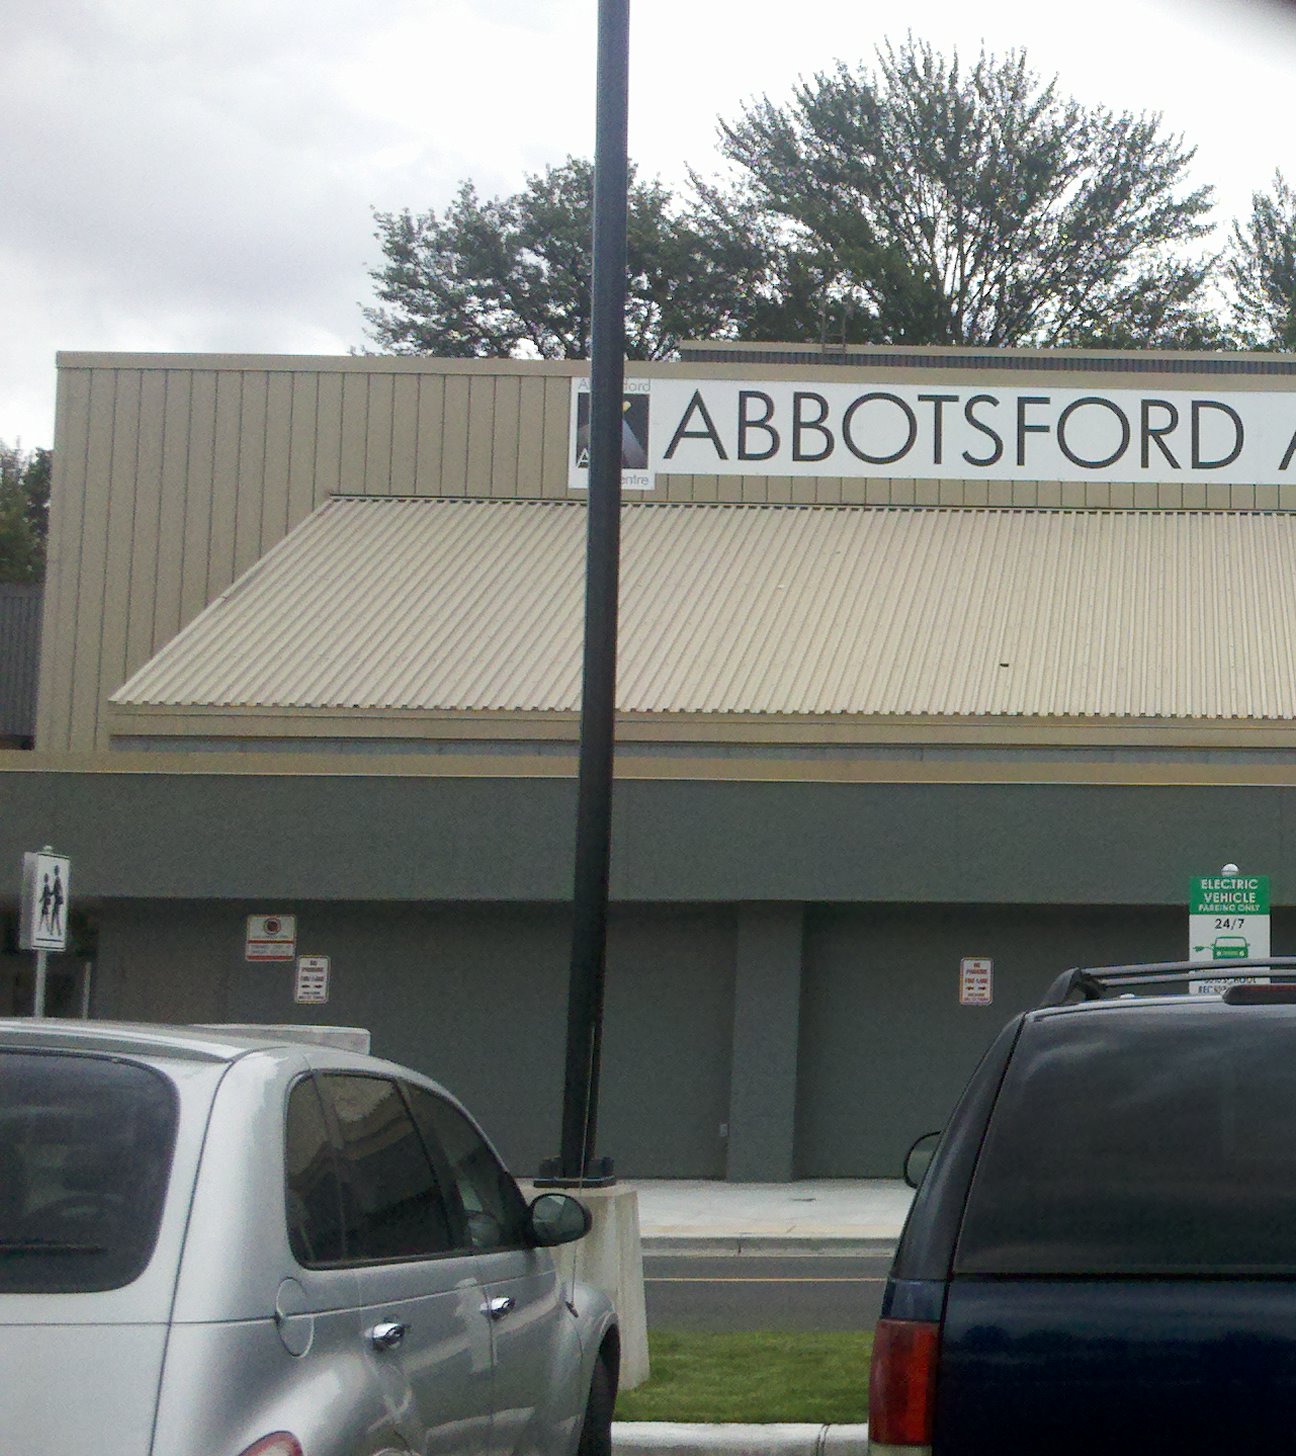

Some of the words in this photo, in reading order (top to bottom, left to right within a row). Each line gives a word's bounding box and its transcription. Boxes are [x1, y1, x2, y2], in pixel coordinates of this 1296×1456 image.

[663, 388, 1245, 470] ABBOTSFORD
[1201, 879, 1259, 890] ELECTRIC
[1203, 892, 1256, 903] VEHICLE
[1198, 904, 1237, 912] PARKING
[1237, 904, 1261, 912] ONLY
[1214, 918, 1245, 931] 24/7
